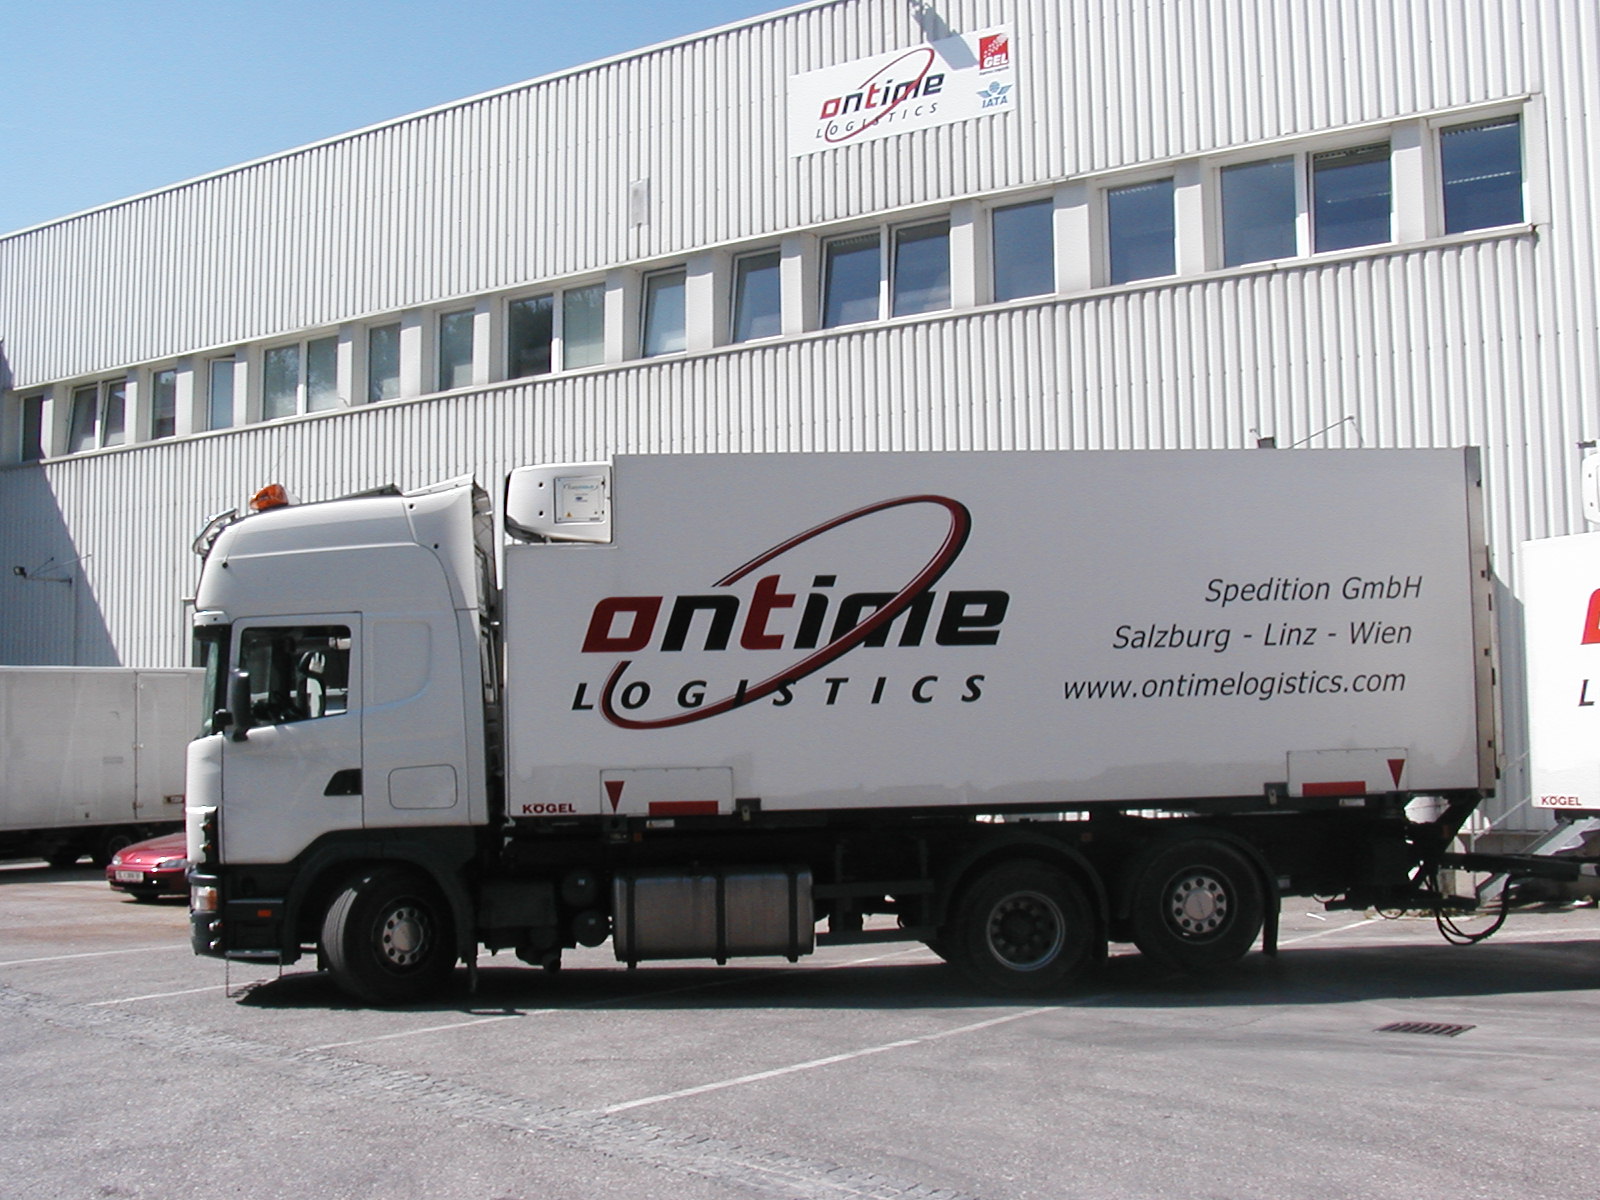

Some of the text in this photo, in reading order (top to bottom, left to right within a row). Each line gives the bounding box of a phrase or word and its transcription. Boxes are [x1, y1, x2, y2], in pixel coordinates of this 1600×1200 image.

[983, 53, 1009, 68] GEL
[819, 73, 945, 120] ontime
[982, 95, 1008, 108] IATA
[815, 102, 938, 139] LOGISTICS
[1204, 575, 1423, 608] Spedition GmbH
[581, 574, 1010, 653] ontime
[1112, 623, 1231, 653] Salzburg
[1264, 622, 1317, 647] Linz
[1350, 621, 1412, 645] Wien
[571, 674, 986, 711] LOGISTICS
[1063, 669, 1407, 702] www.ontimelogistics.com
